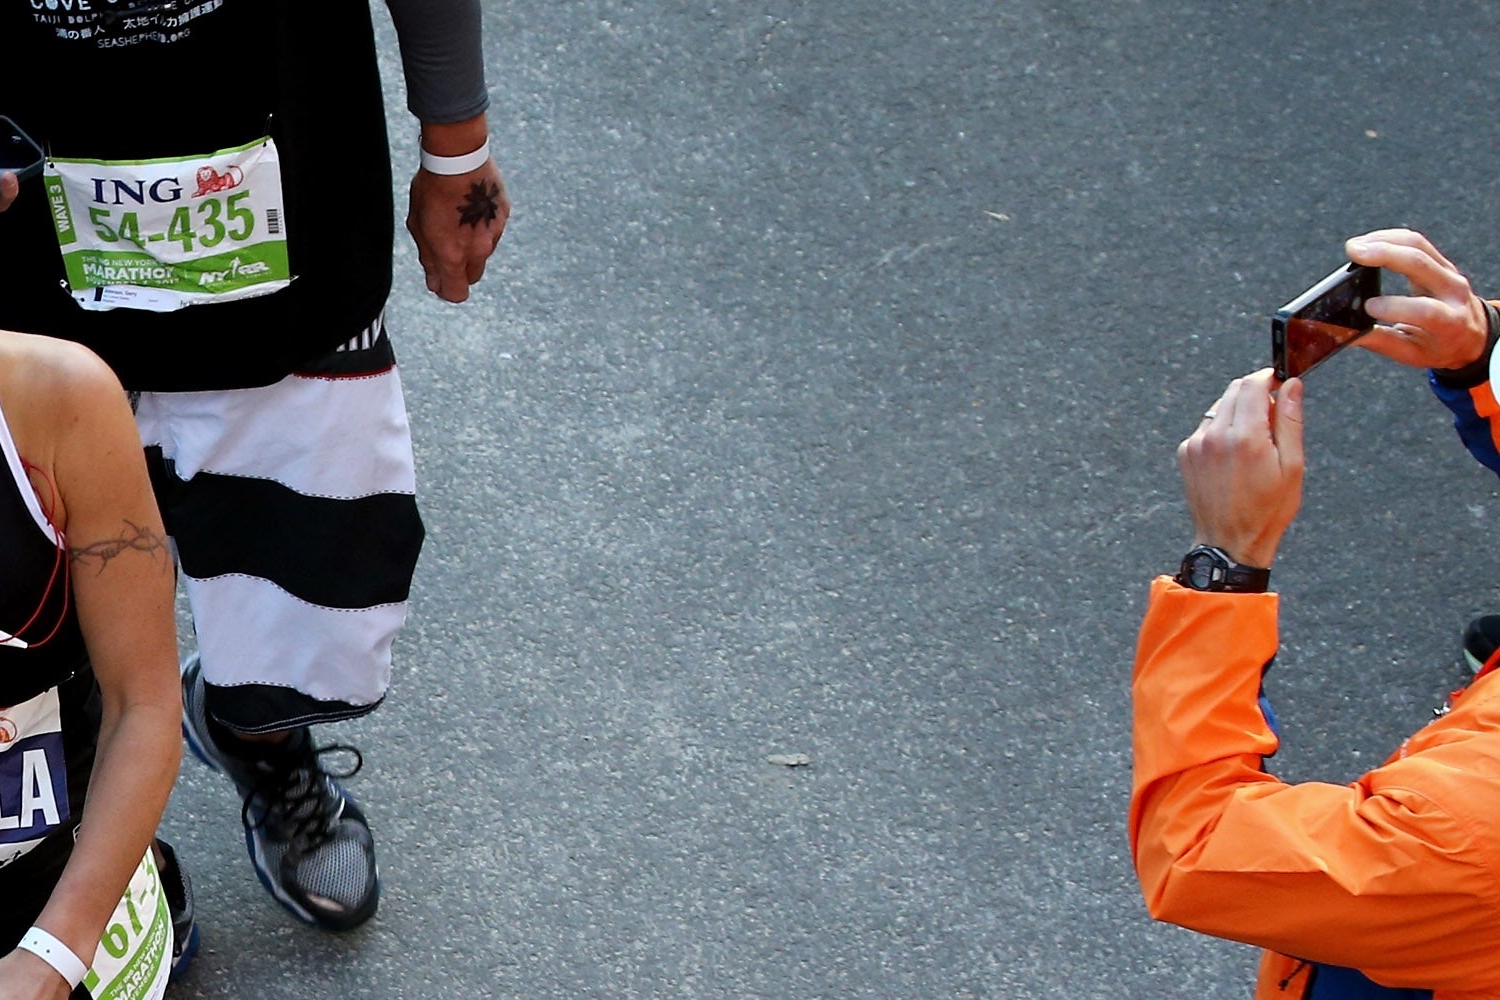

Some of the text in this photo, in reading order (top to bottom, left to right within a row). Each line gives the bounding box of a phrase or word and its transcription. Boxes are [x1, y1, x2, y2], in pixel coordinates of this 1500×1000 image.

[33, 13, 104, 24] TAIJI DOLP
[49, 184, 71, 234] WAVE 3
[91, 177, 184, 205] ING
[88, 189, 255, 252] 54-435
[112, 259, 133, 267] NEW
[109, 981, 124, 1000] THE
[133, 952, 146, 970] NEW
